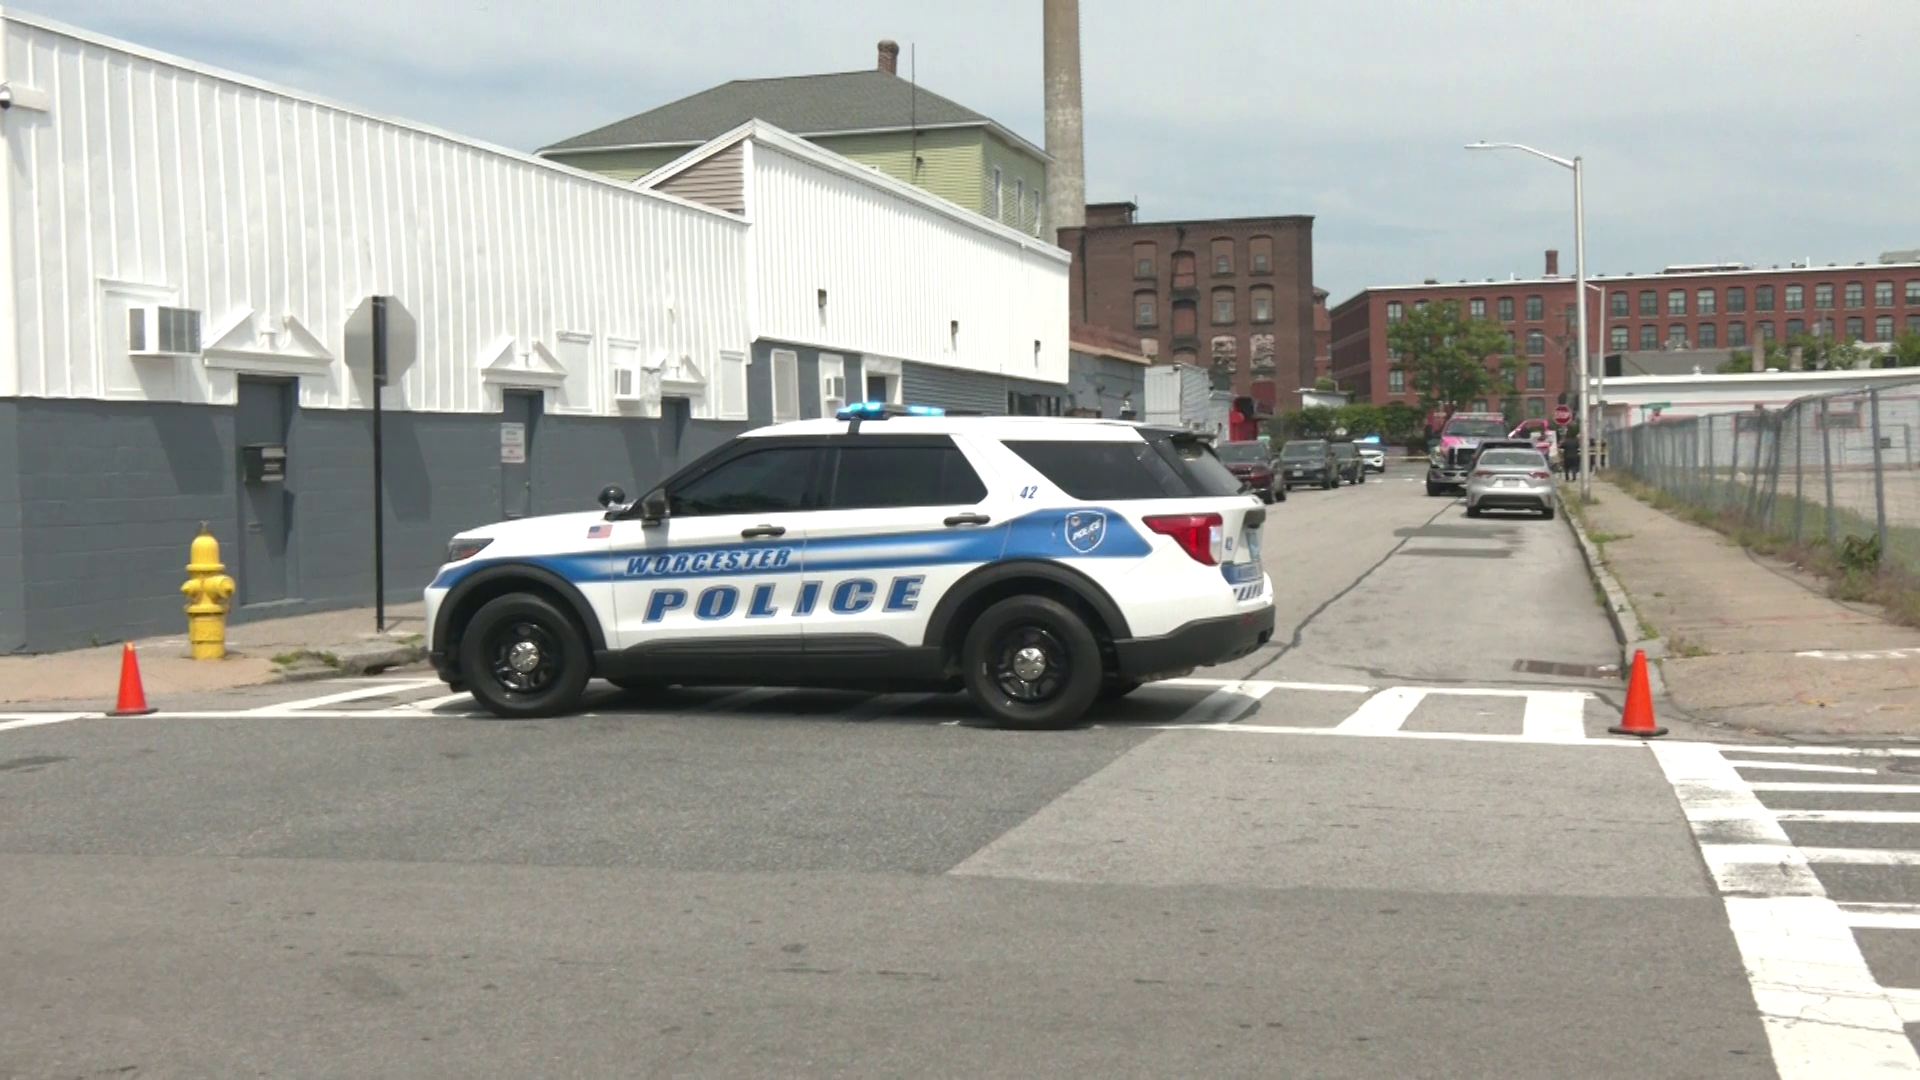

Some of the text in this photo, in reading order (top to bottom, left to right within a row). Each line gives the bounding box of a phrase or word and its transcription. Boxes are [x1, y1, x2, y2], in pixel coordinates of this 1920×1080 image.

[1020, 485, 1038, 499] 42
[624, 547, 793, 576] WORCESTER
[642, 574, 926, 624] POLICE
